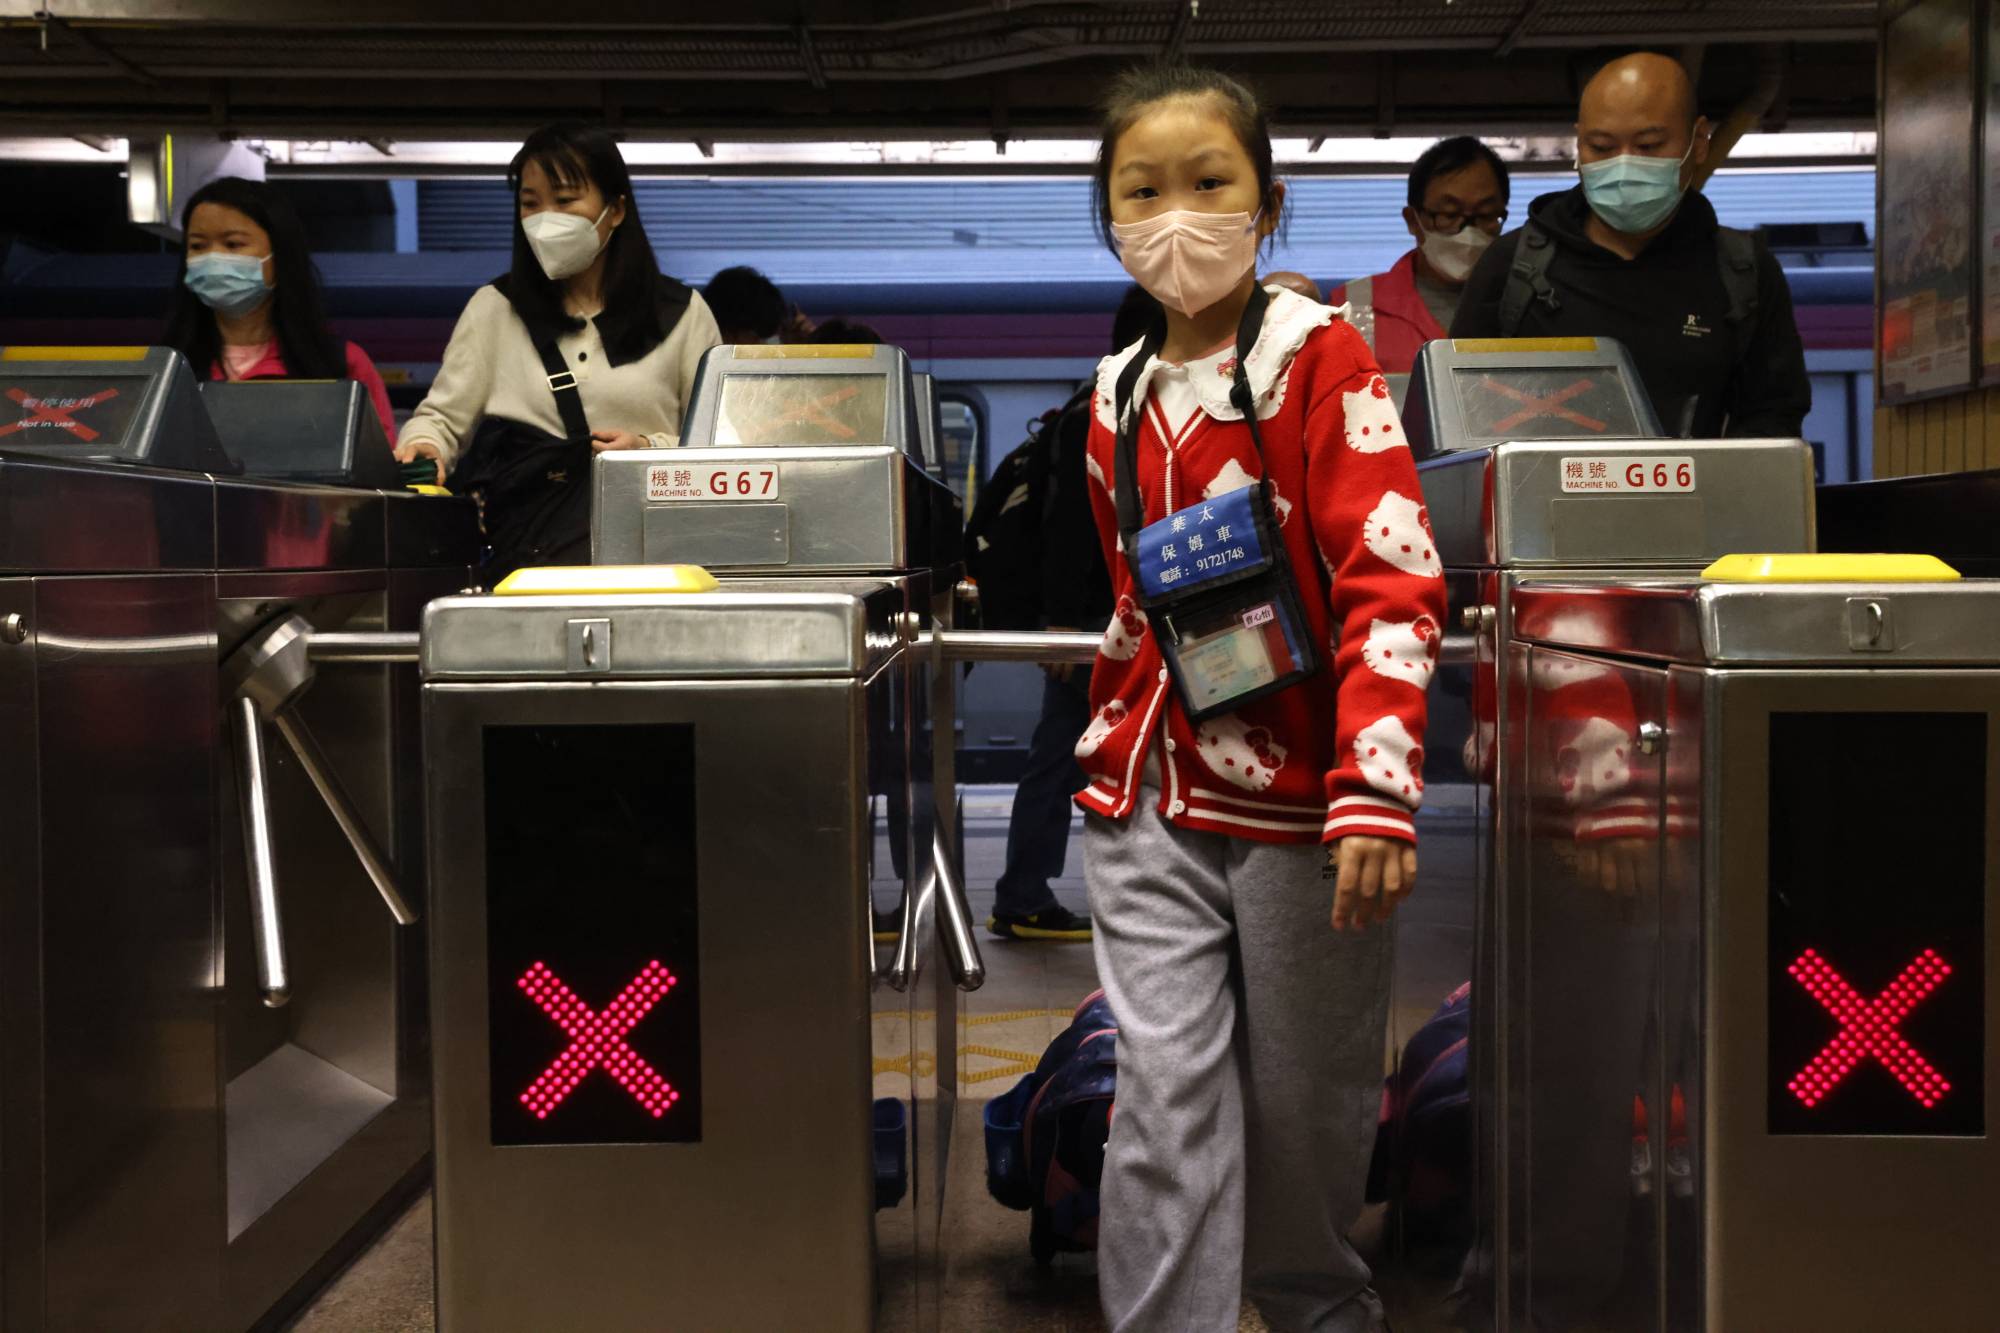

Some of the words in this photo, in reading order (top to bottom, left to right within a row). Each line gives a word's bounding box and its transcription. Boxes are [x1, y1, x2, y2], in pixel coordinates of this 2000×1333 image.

[17, 420, 38, 428] Not
[651, 469, 692, 487] 機號
[1566, 461, 1607, 479] 機號
[1625, 463, 1691, 488] G66
[651, 489, 688, 497] MACHINE
[689, 489, 704, 497] NO.
[709, 470, 774, 495] G67
[1566, 481, 1603, 489] MACHINE
[1605, 481, 1620, 489] NO.
[1170, 505, 1215, 535] 葉太
[1161, 525, 1233, 562] 保姆車
[1196, 546, 1245, 571] 91721748
